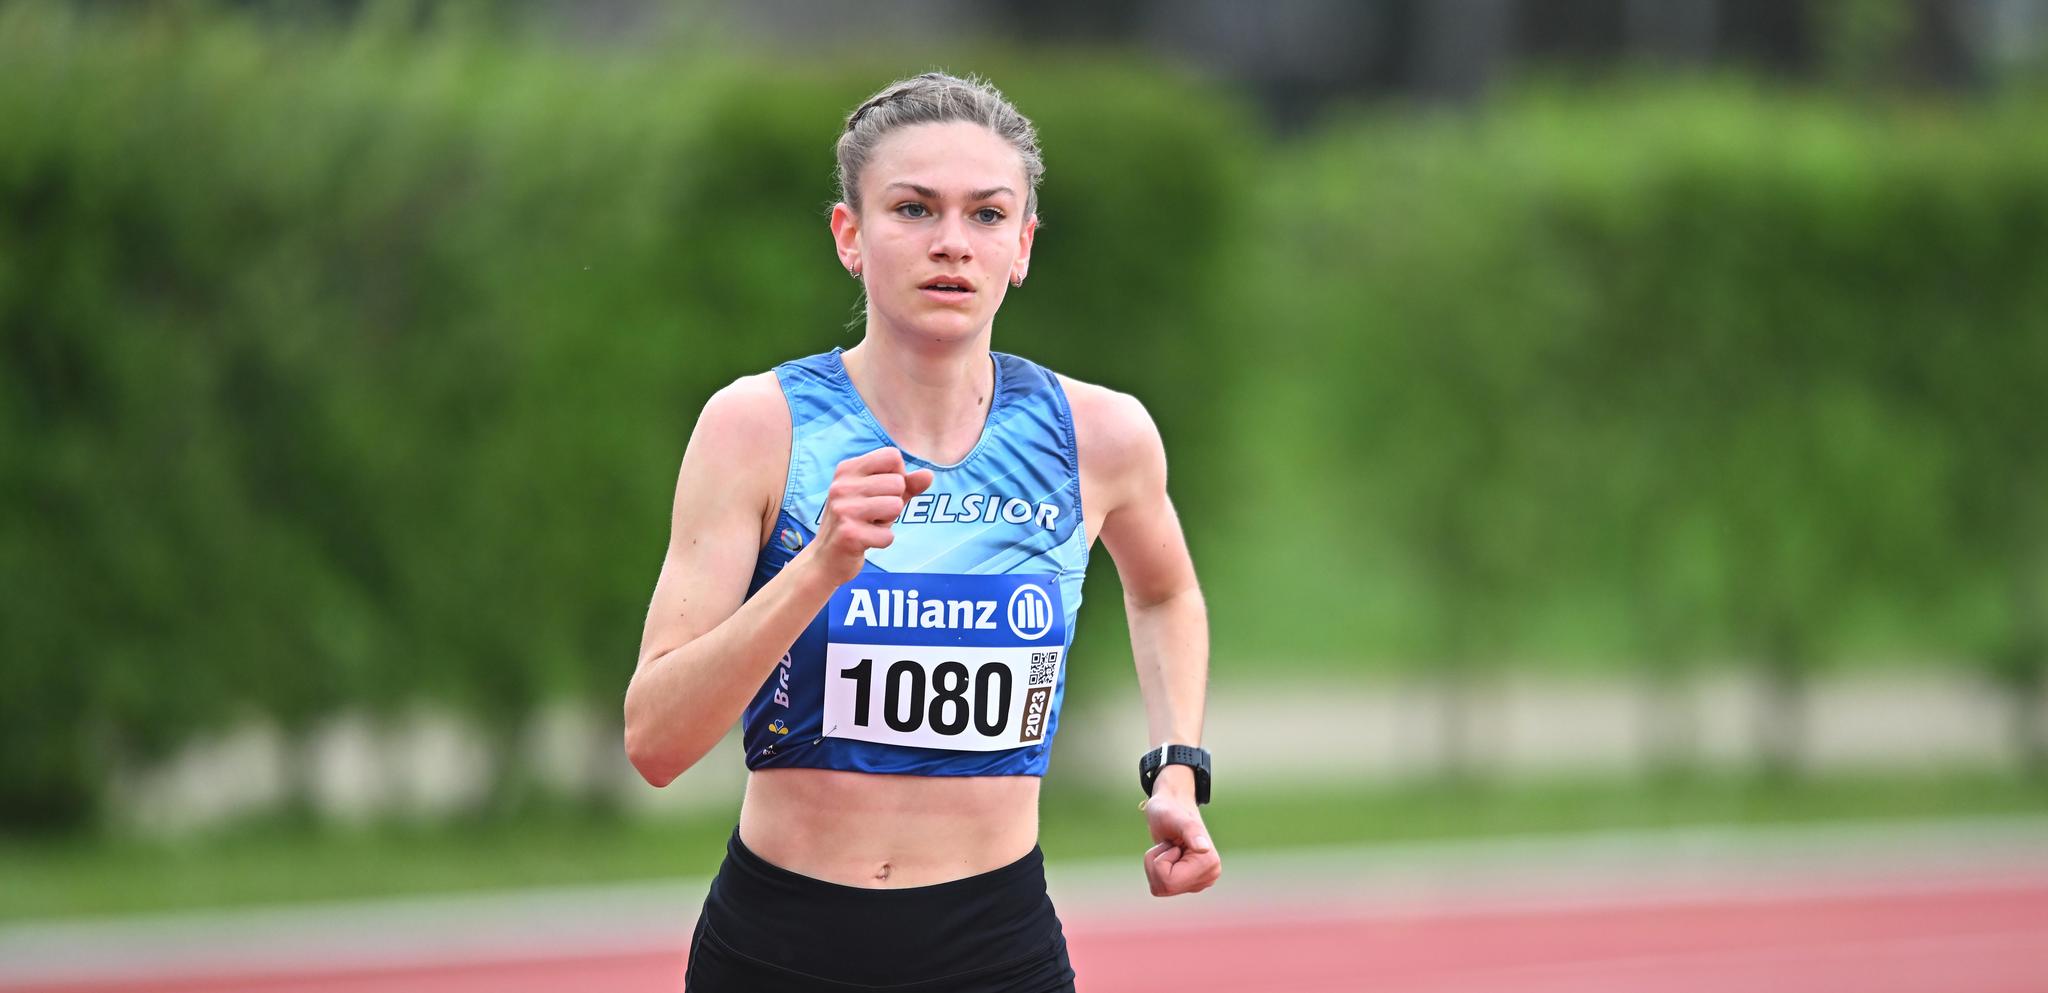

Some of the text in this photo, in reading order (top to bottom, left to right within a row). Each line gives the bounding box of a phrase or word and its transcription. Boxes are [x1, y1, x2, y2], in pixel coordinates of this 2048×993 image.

[815, 493, 1060, 531] ELSIOR
[843, 589, 998, 630] Allianz
[840, 659, 1013, 737] 1080
[1025, 691, 1046, 737] 2023
